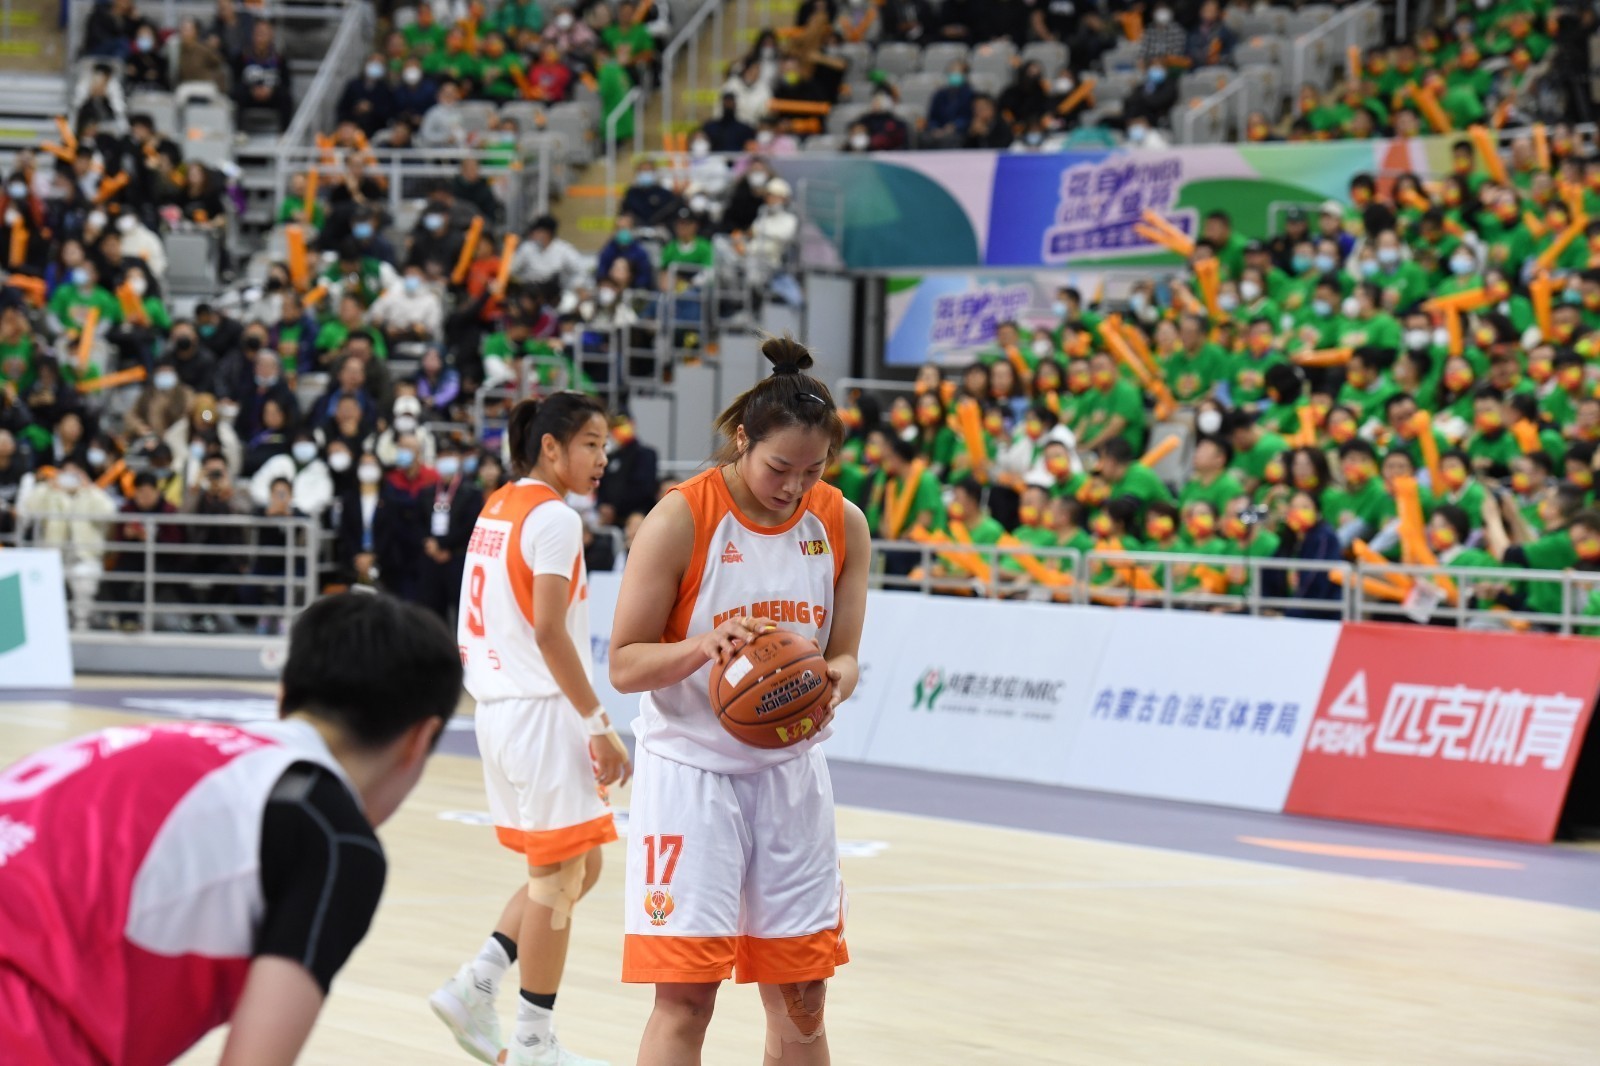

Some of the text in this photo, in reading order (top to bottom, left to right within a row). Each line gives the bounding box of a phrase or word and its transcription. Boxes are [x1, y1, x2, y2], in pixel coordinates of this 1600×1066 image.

[721, 553, 744, 564] PEAK
[466, 563, 486, 638] 9
[751, 600, 811, 624] MENG
[755, 674, 823, 716] PRECISION
[1092, 686, 1300, 737] 内蒙古自治区体育局
[1307, 719, 1374, 757] PEAK
[1374, 683, 1585, 770] 匹克体育
[643, 834, 684, 885] 17
